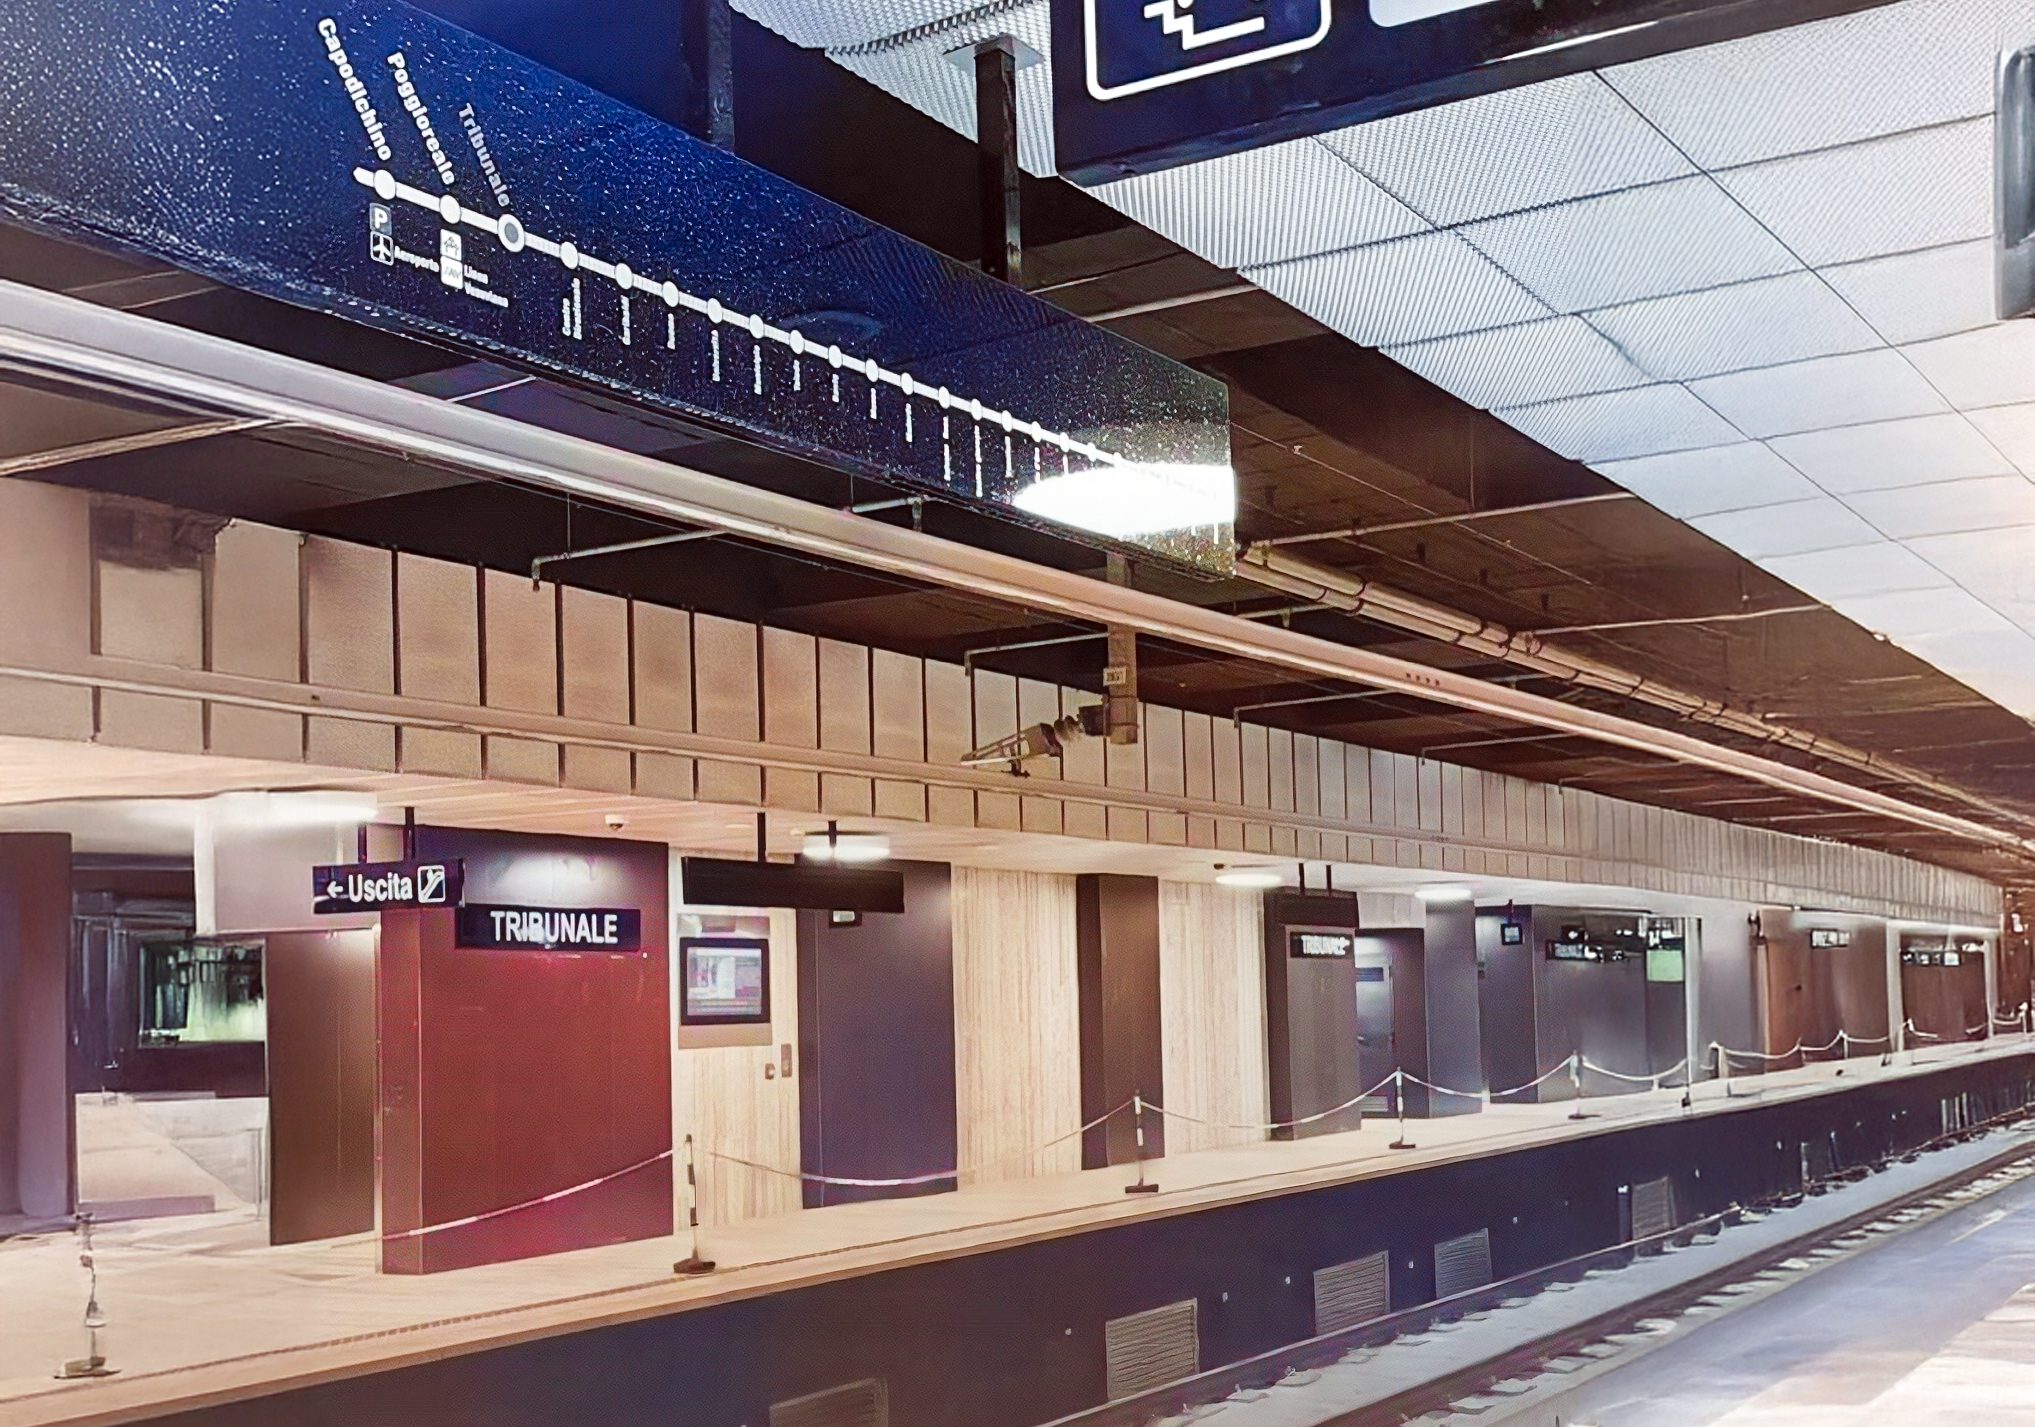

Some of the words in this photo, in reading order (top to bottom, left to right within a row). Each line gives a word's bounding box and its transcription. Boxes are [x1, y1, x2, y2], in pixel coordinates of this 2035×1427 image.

[318, 18, 392, 161] Capodichino
[387, 52, 455, 185] Poggioreale
[458, 103, 510, 207] Tribunale
[348, 871, 413, 902] Uscita
[490, 910, 618, 944] TRIBUNALE
